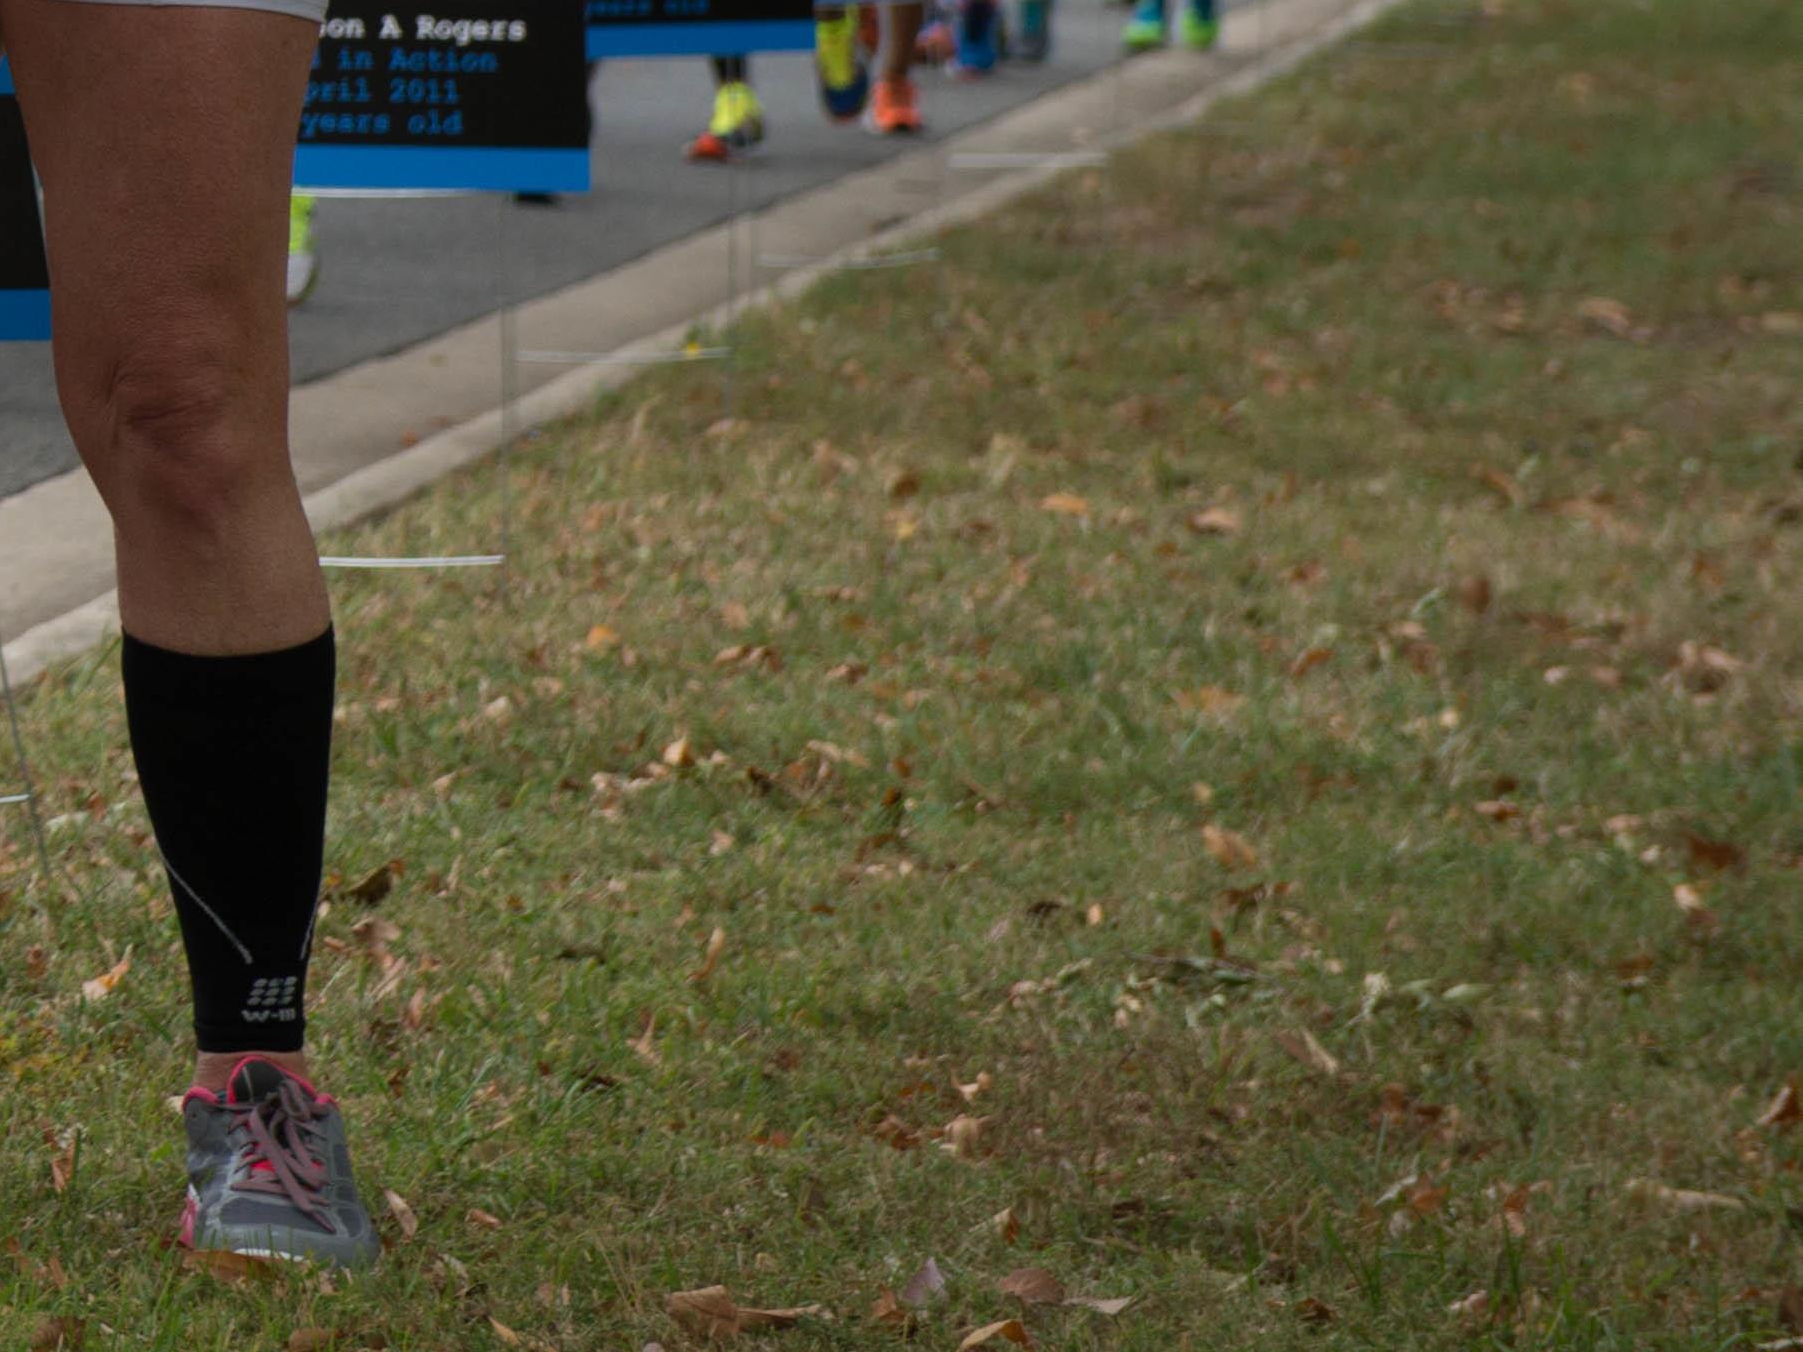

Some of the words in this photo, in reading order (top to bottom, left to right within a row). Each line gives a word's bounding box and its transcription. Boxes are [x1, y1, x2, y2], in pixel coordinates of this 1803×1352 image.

[320, 17, 366, 39] on
[379, 14, 402, 39] A
[415, 14, 528, 46] Rogers
[338, 47, 374, 70] in
[389, 47, 498, 73] Action
[303, 76, 371, 108] pril
[390, 78, 459, 104] 2011
[301, 112, 390, 138] years
[408, 108, 464, 135] old
